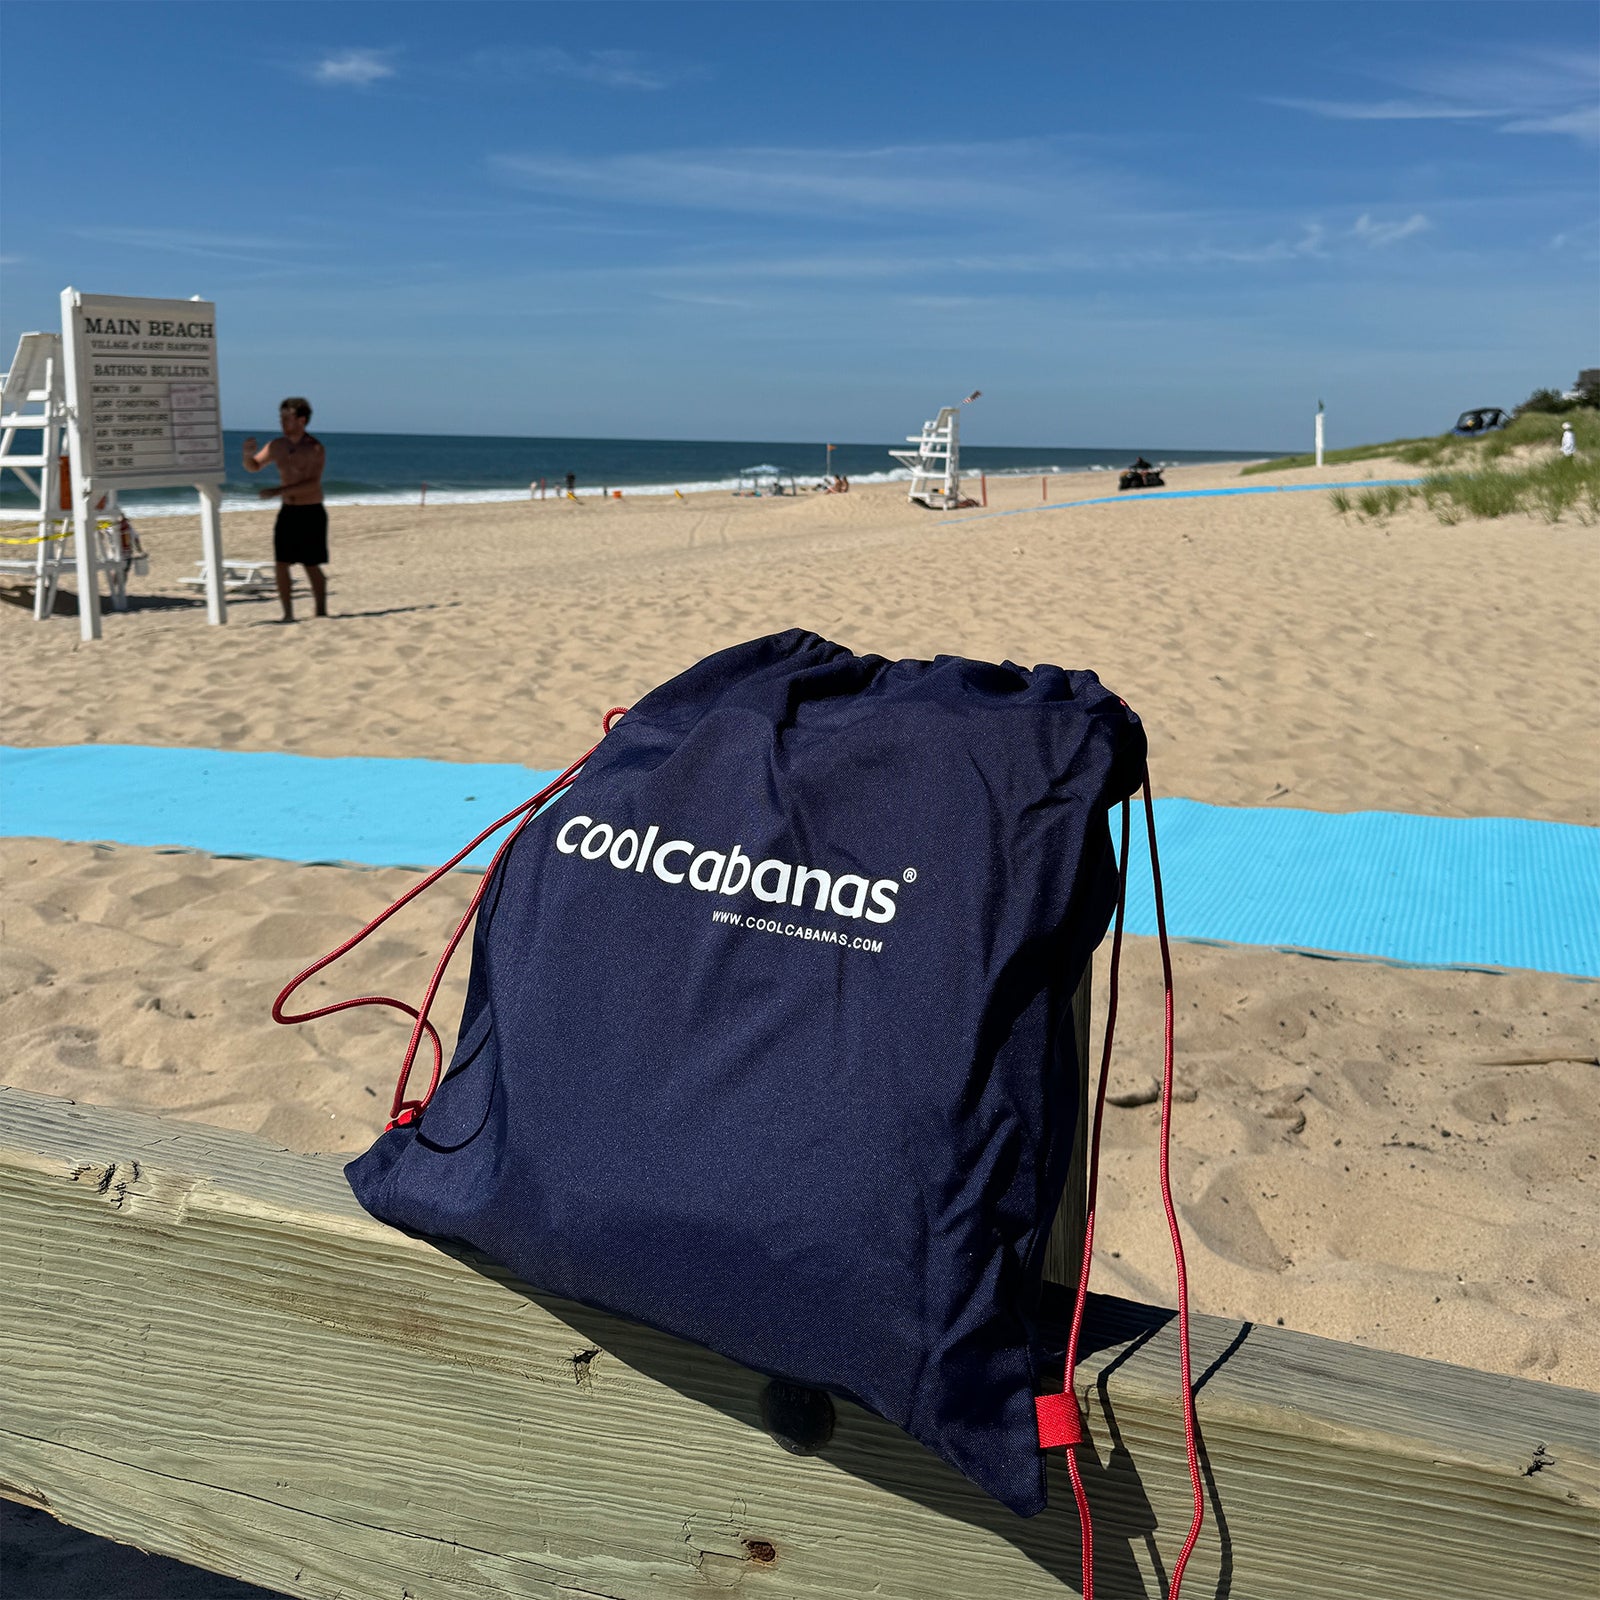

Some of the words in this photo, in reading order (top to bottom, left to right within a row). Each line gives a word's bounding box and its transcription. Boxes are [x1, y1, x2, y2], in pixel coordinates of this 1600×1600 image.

[85, 318, 141, 335] MAIN
[148, 321, 214, 338] BEACH
[91, 340, 129, 350] VILLAGE
[142, 342, 164, 351] EAST
[167, 343, 209, 352] HAMPTON
[94, 365, 147, 377] BATHING
[151, 366, 210, 378] BULLETIN
[712, 910, 883, 953] WWW.COOLCABANAS.COM
